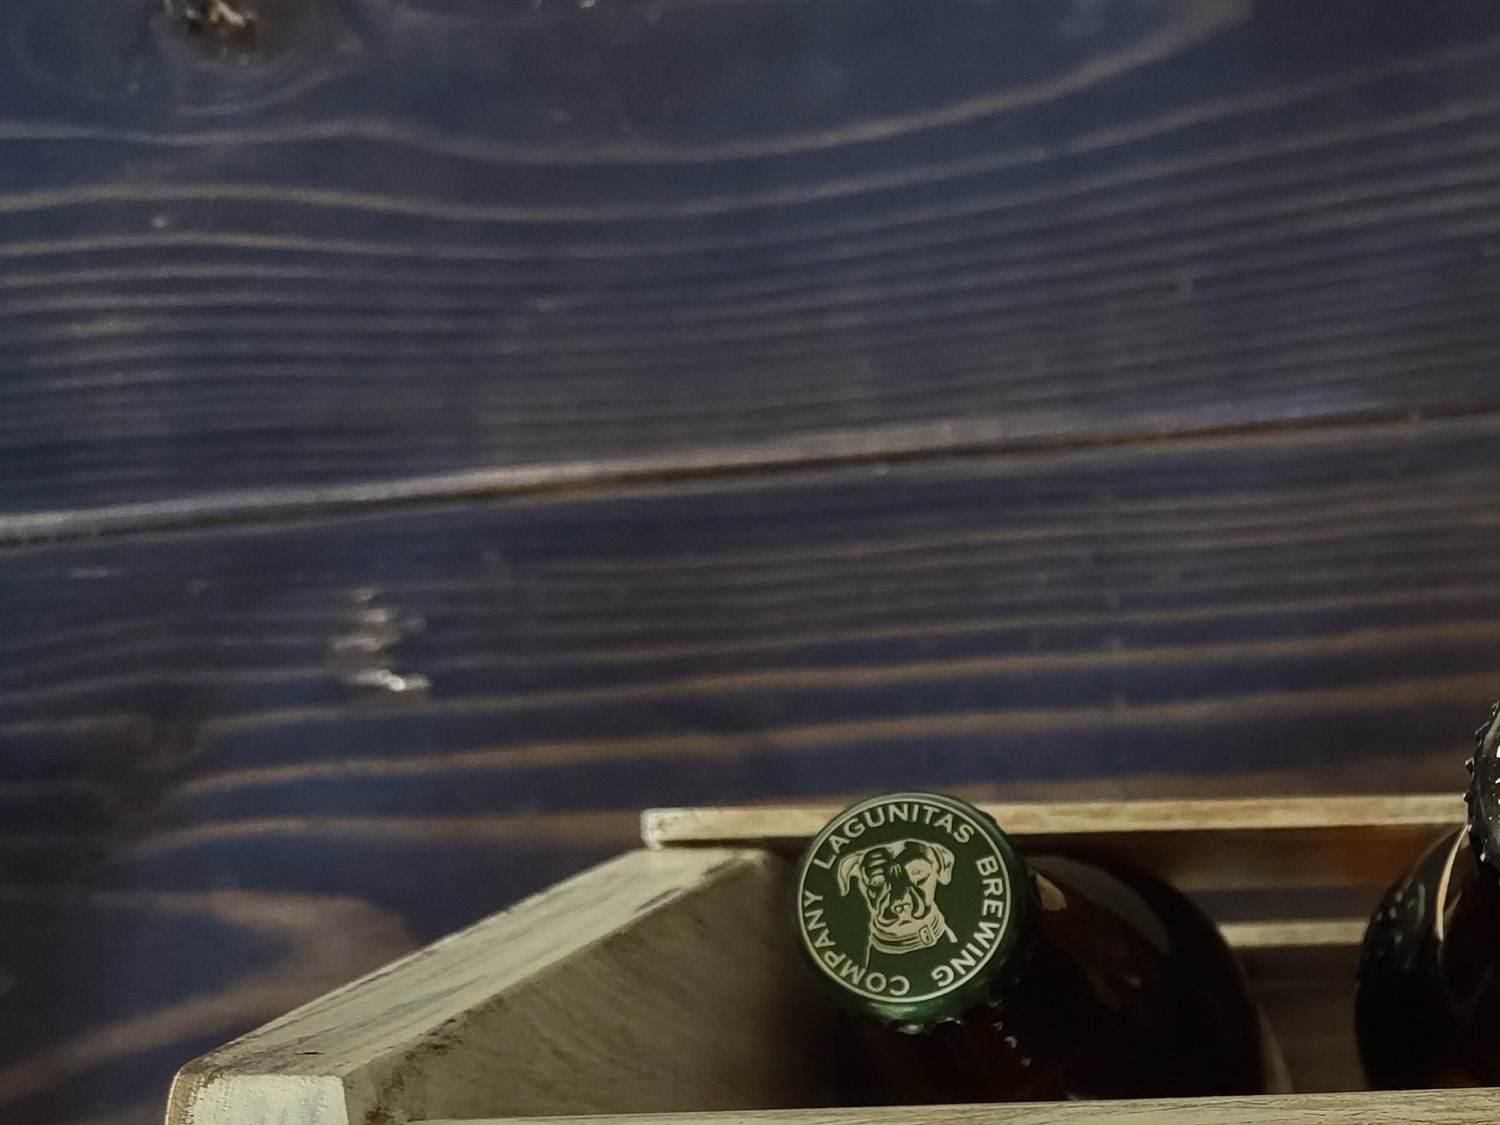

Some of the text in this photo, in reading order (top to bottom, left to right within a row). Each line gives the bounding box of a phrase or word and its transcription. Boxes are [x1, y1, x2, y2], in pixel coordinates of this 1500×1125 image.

[803, 803, 1004, 996] LAGUNITAS BREWING COMPANY
